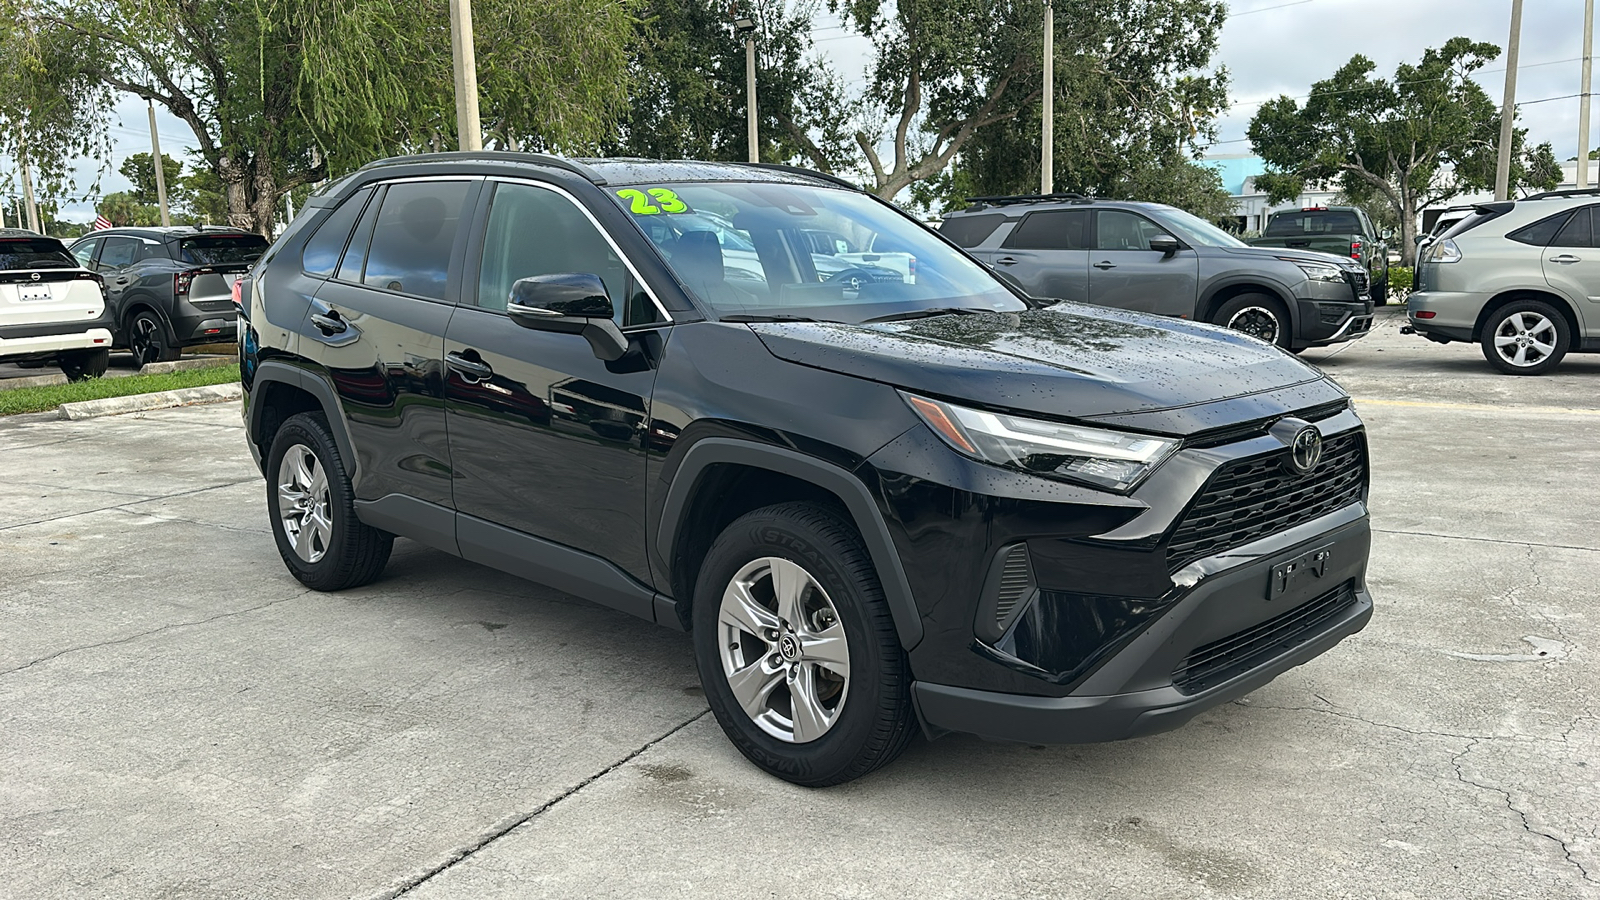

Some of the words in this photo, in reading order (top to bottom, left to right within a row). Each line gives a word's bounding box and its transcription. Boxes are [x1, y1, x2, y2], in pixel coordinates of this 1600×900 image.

[615, 187, 688, 215] 23
[764, 530, 853, 608] STRATUS
[709, 686, 796, 774] MASTERC
